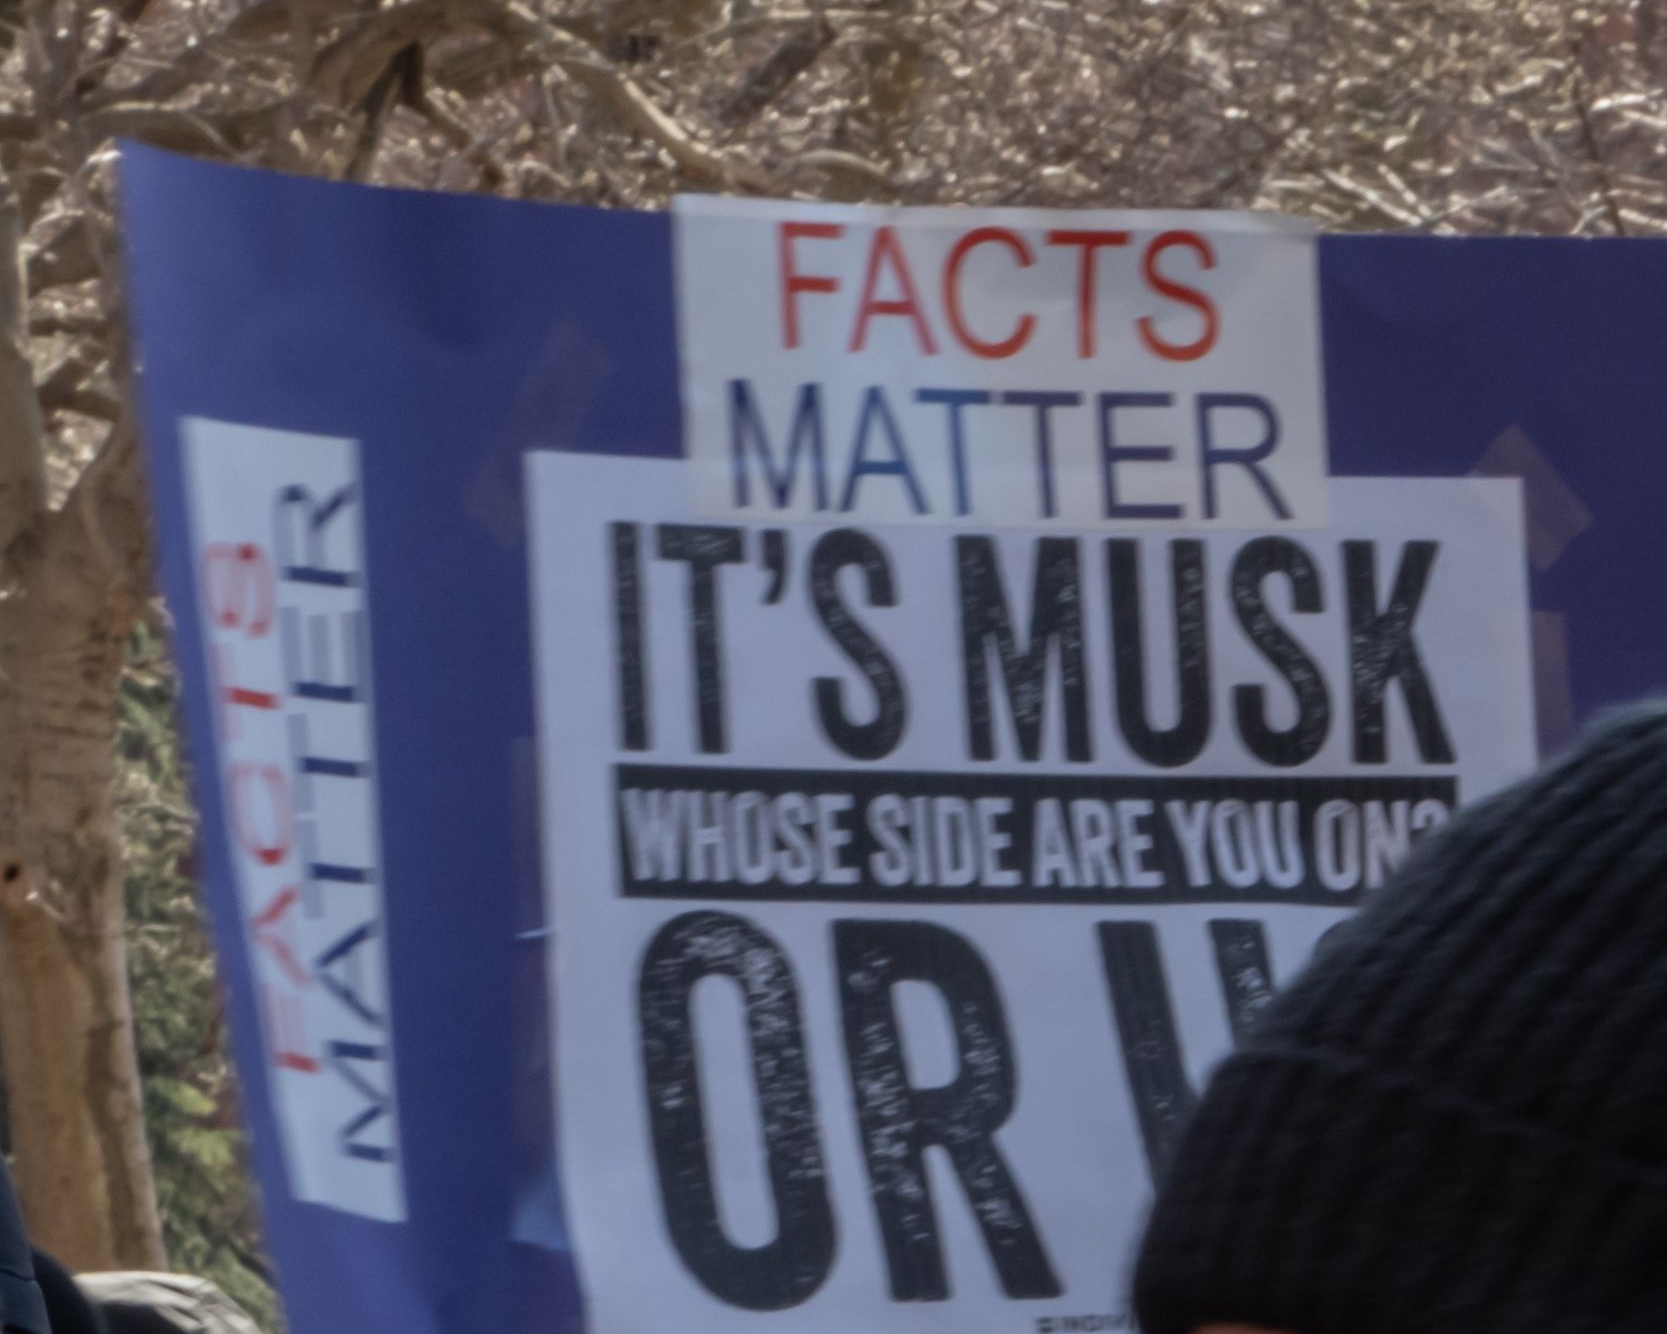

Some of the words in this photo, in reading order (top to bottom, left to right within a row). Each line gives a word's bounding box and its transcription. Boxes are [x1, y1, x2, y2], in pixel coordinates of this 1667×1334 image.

[777, 221, 1221, 361] FACTS
[726, 378, 1296, 520] MATTER
[612, 521, 910, 761] IT'S
[954, 533, 1457, 767] MUSK
[203, 542, 323, 1074] FACTS
[272, 479, 395, 1165] MATTER
[621, 787, 861, 885] WHOSE
[866, 793, 1022, 887] SIDE
[1032, 797, 1165, 888] ARE
[1164, 798, 1306, 889] YOU
[637, 909, 1065, 1312] OR
